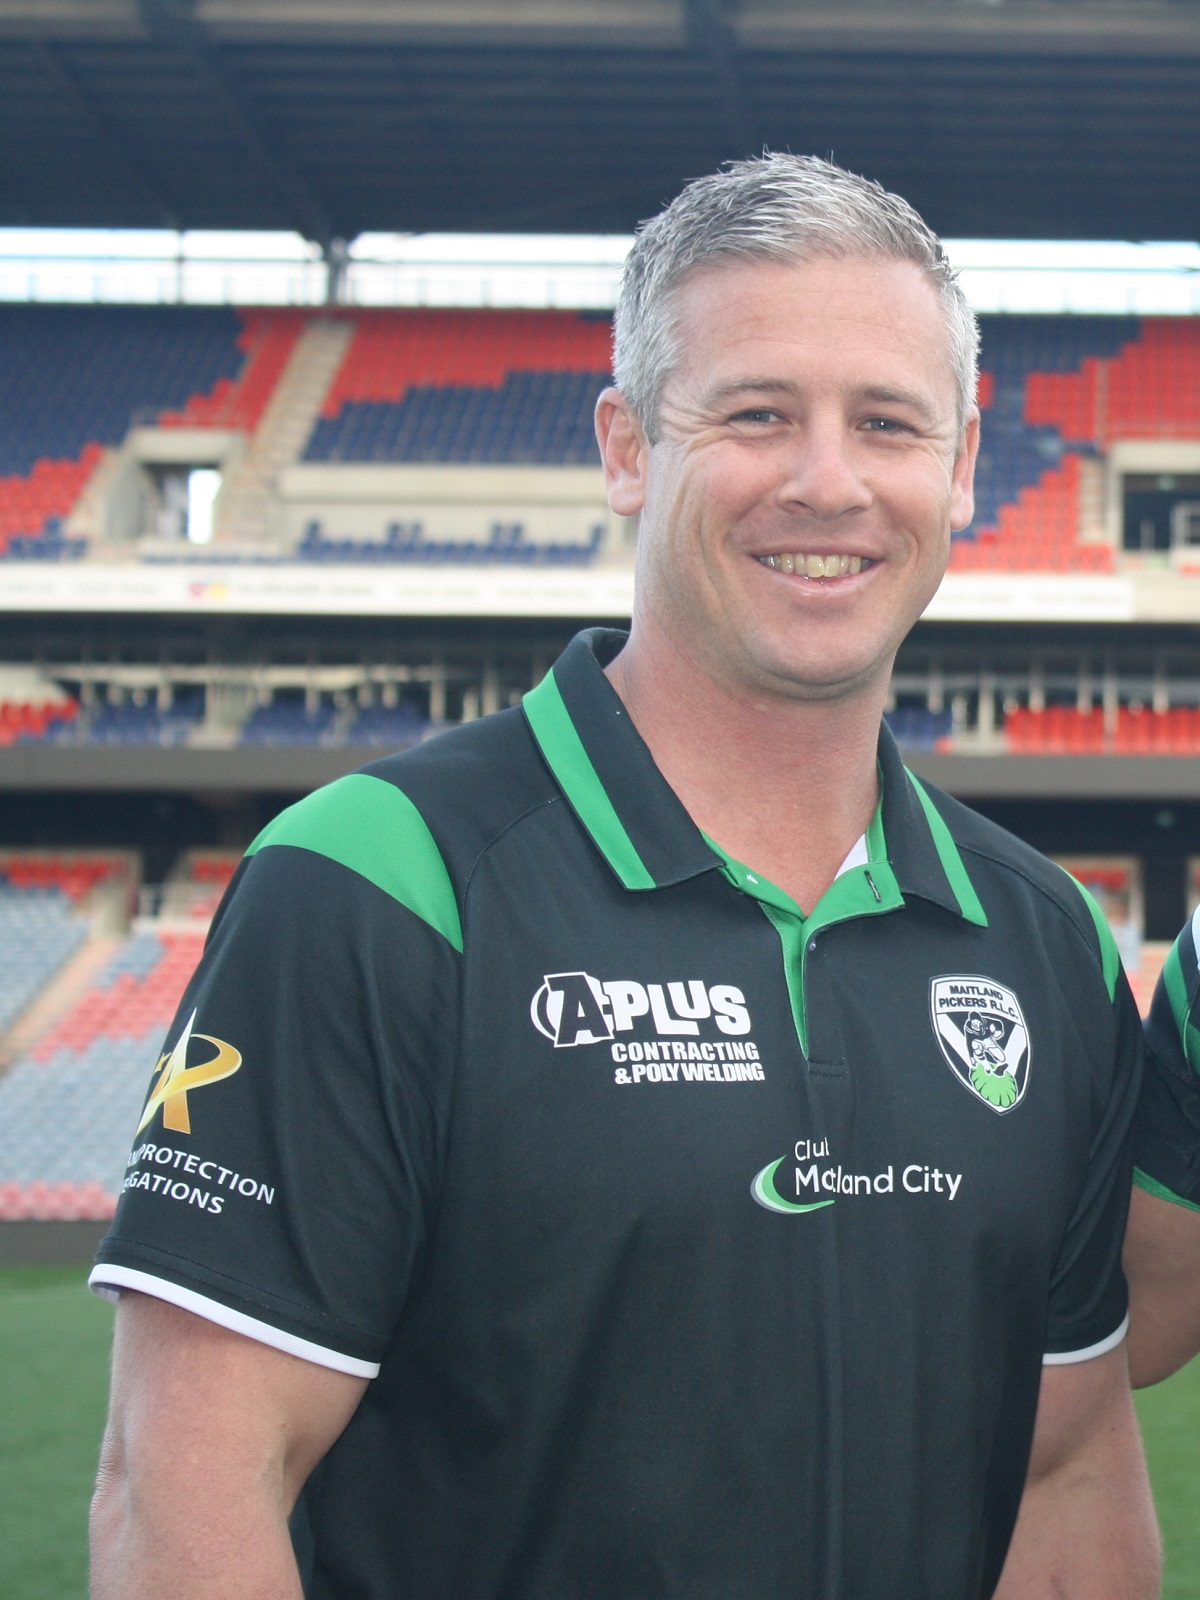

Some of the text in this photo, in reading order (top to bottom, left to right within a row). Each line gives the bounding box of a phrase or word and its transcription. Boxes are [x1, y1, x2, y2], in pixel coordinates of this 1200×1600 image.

[949, 985, 1004, 1001] MAITLAND
[938, 997, 1019, 1019] PICKERS R.L.C.
[611, 1041, 761, 1063] CONTRACTING
[614, 1062, 766, 1085] & POLY WELDING
[902, 1164, 963, 1201] City
